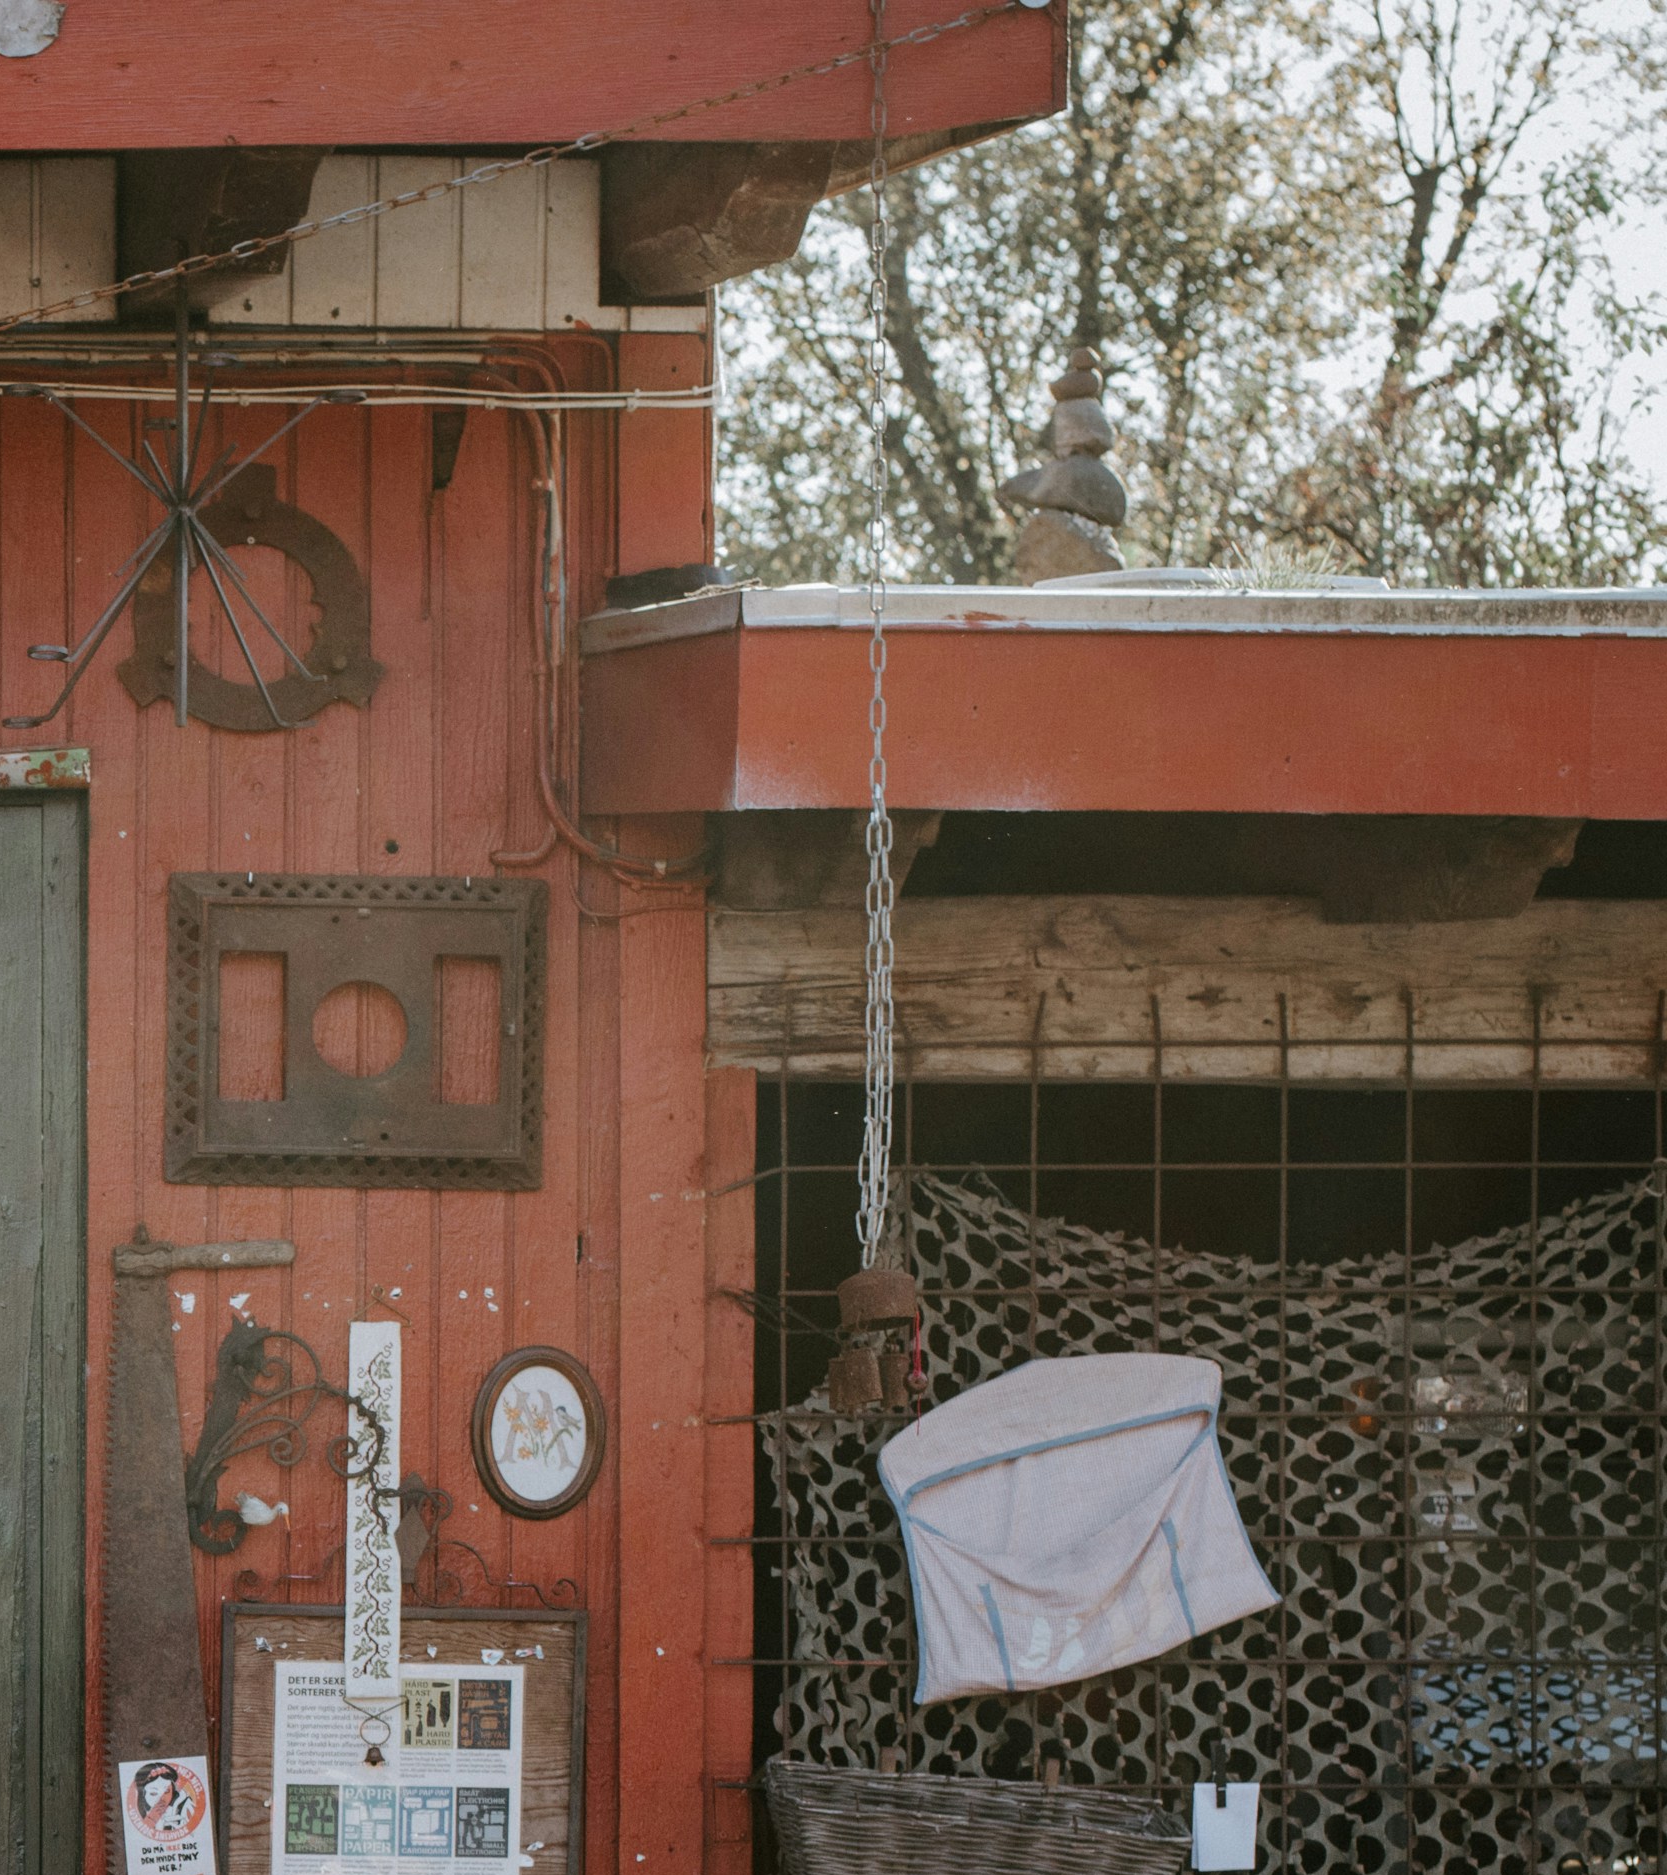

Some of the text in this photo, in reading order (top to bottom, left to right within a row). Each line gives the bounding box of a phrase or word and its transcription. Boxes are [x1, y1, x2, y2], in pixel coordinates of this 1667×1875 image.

[288, 1676, 346, 1685] DET ER SEXE
[405, 1680, 428, 1689] HÅRD
[288, 1687, 336, 1697] SORTERER
[405, 1689, 430, 1697] PLAST
[427, 1730, 450, 1738] HARD
[344, 1788, 392, 1800] PAPIR
[458, 1797, 506, 1805] ELEKTRONIK
[182, 1842, 198, 1850] RIDE
[344, 1841, 391, 1853] PAPER
[457, 1848, 506, 1856] ELECTRONICS
[141, 1851, 199, 1865] DEN HVIDE PONY
